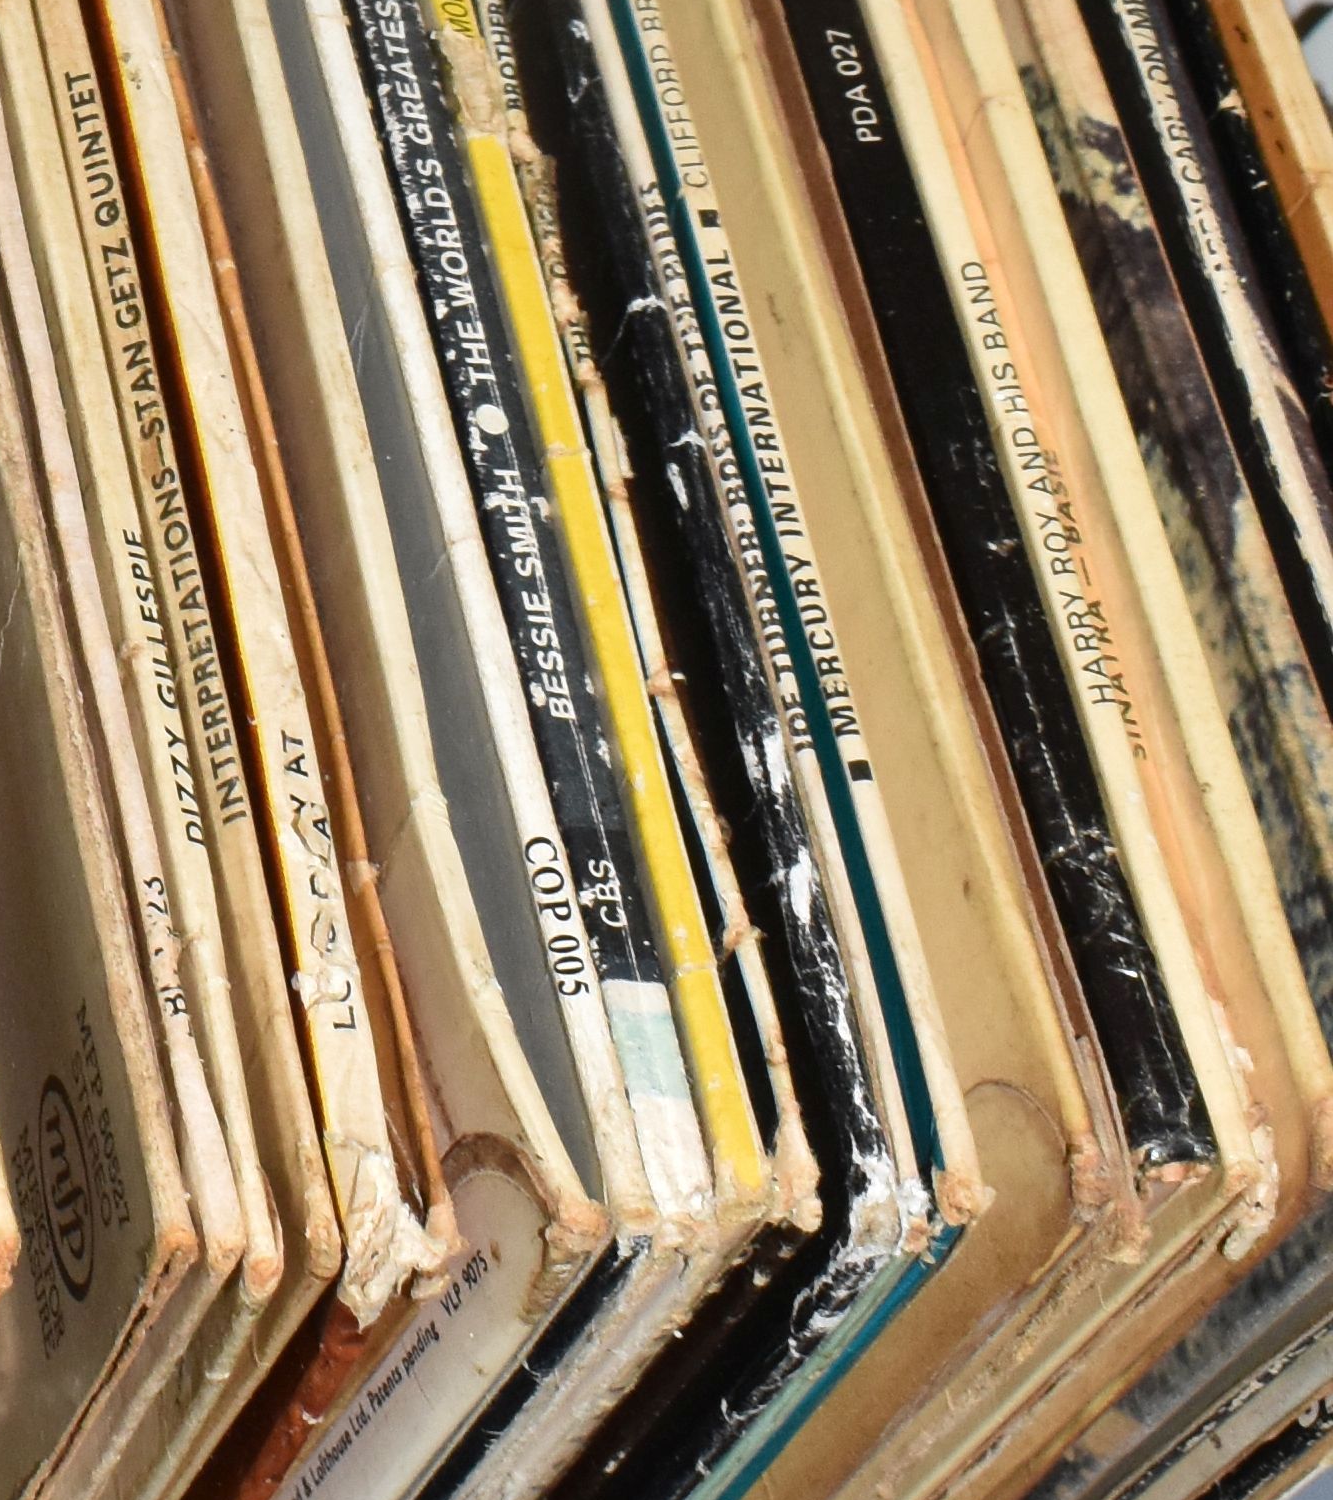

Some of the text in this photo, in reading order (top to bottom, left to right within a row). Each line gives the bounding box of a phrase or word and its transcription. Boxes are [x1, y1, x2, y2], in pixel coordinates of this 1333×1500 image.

[824, 27, 865, 74] 027
[842, 82, 886, 142] PDA
[62, 70, 145, 327] GETZ QUINTET
[410, 156, 474, 307] WORLD'S
[452, 319, 494, 386] THE
[701, 247, 806, 537] INTERNATIONAL
[489, 466, 543, 577] SMITH
[957, 259, 1119, 704] HARRY ROY AND BAND
[520, 589, 579, 719] BESSIE
[787, 553, 863, 737] MERCURY
[521, 834, 594, 997] COP 005
[586, 857, 630, 928] CBS
[70, 1049, 115, 1229] STEREO
[367, 1249, 490, 1411] Patents pending VLP 9075
